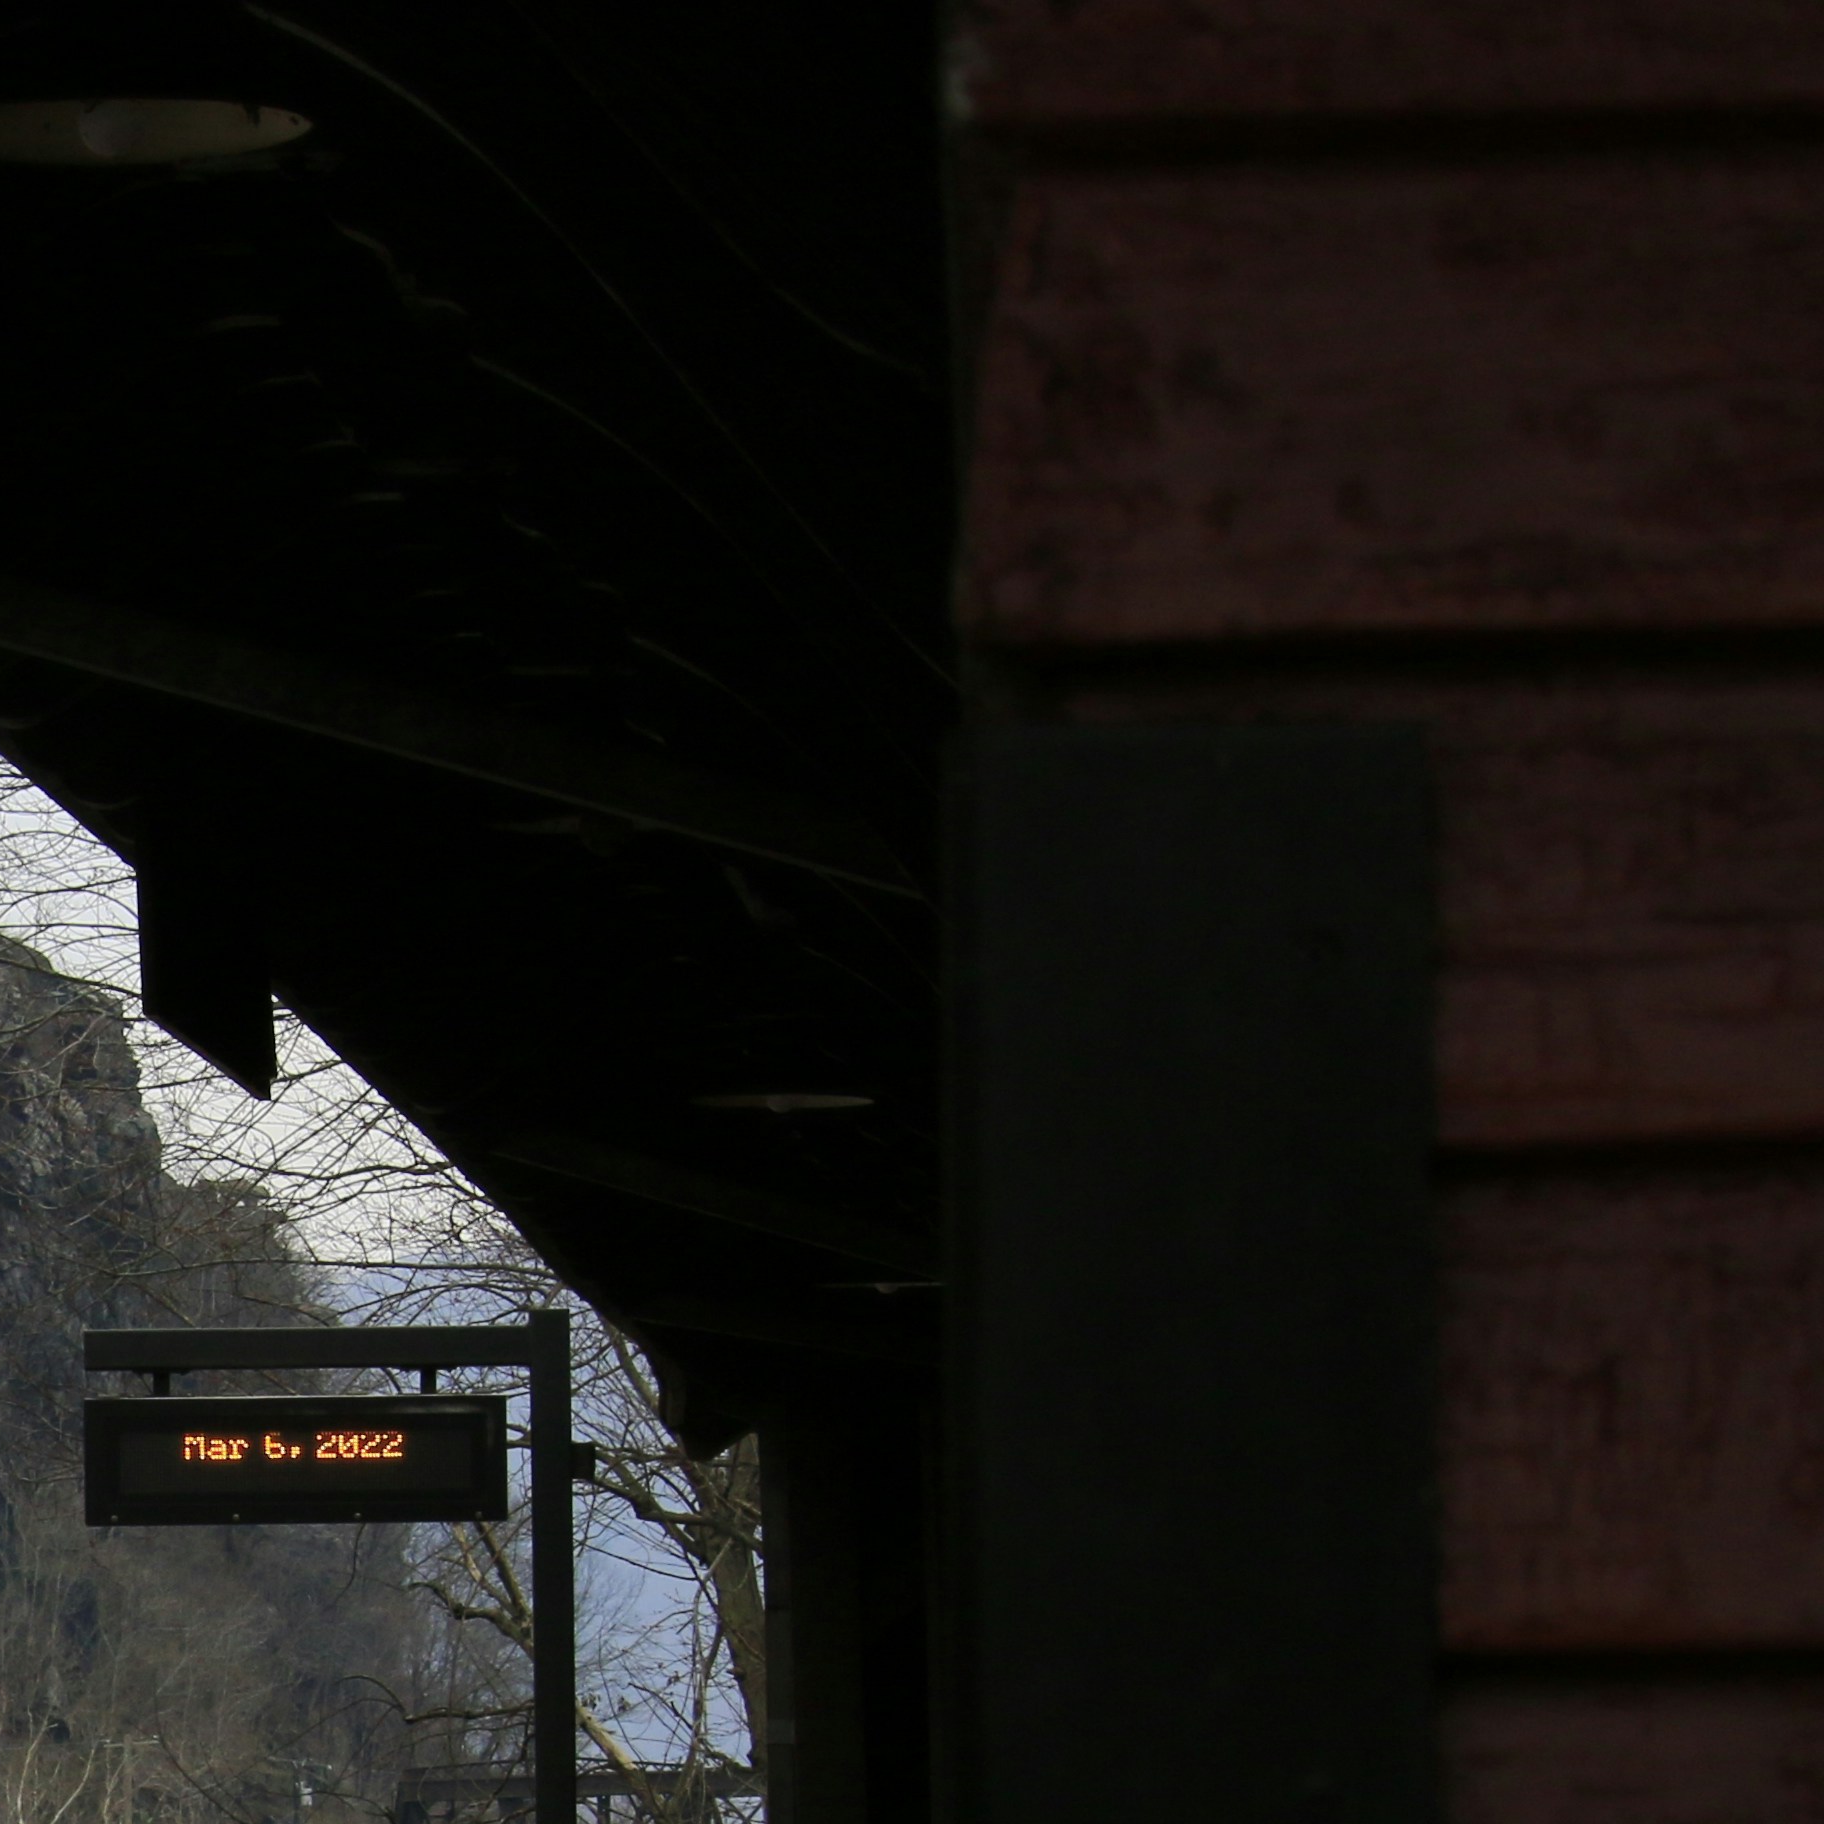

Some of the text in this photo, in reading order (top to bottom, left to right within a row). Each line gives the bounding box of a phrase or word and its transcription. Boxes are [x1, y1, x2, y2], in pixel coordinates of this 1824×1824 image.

[183, 1430, 403, 1461] Mar 6, 2022
